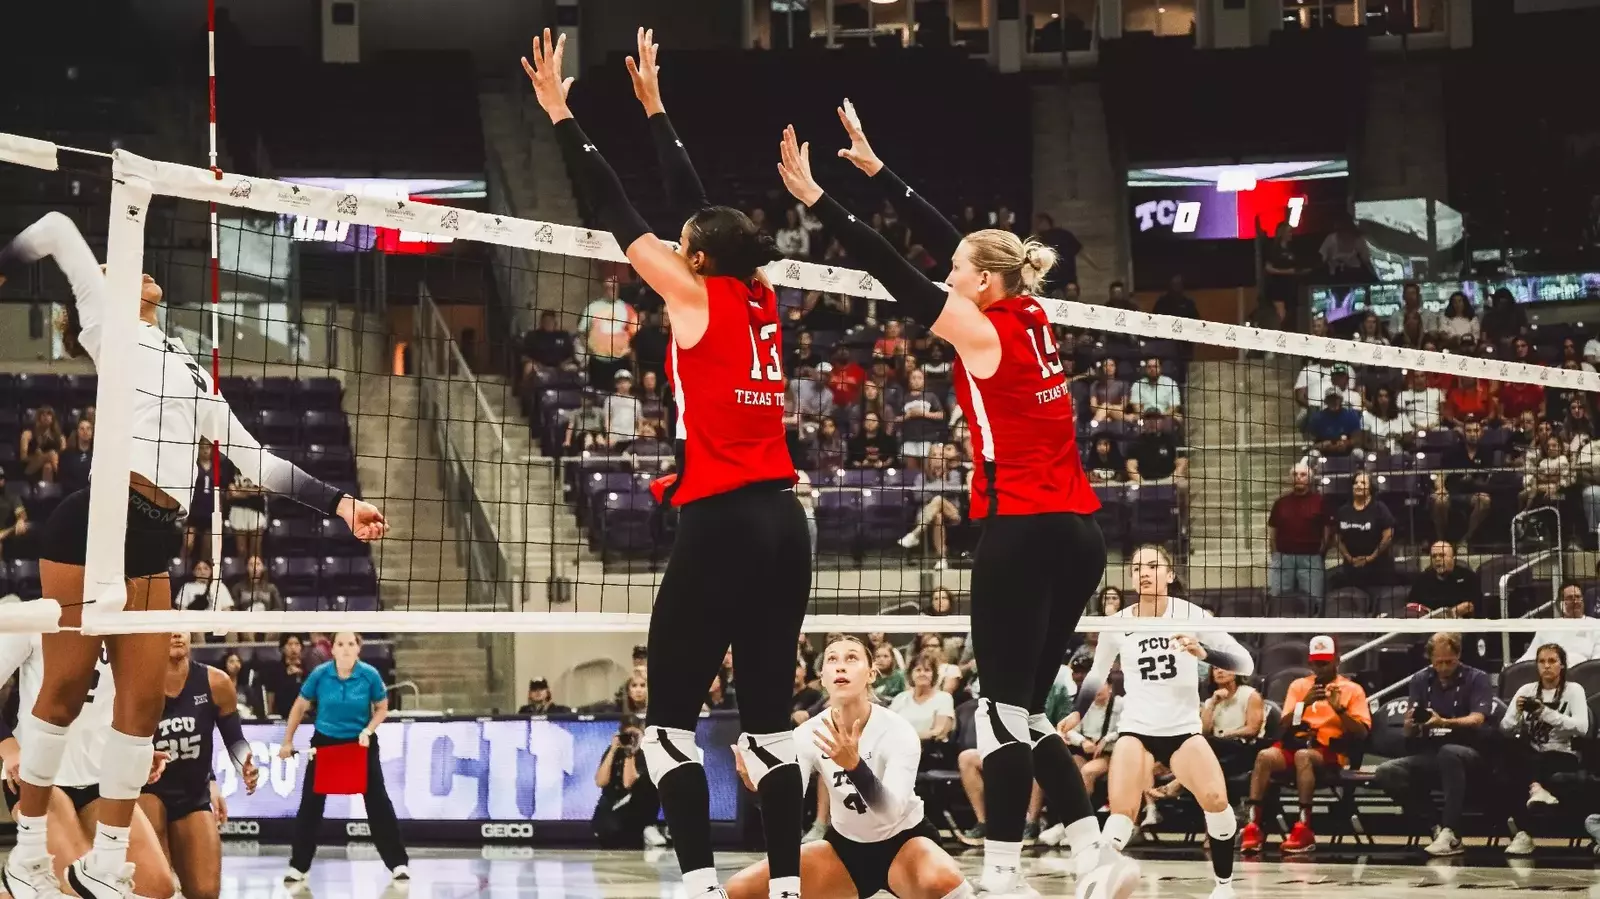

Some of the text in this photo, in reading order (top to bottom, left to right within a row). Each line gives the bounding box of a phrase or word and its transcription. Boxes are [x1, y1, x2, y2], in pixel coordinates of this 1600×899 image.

[1135, 199, 1180, 232] TC
[1172, 202, 1201, 233] 0
[1288, 197, 1304, 228] 1
[748, 323, 782, 381] 13
[735, 388, 784, 406] TEXAS TE
[1035, 384, 1061, 404] TEXAS
[1138, 637, 1170, 653] TCU
[1138, 654, 1177, 680] 23
[1387, 700, 1418, 717] TC
[158, 717, 196, 737] TCU
[843, 793, 867, 814] 4
[481, 823, 533, 838] GEICO
